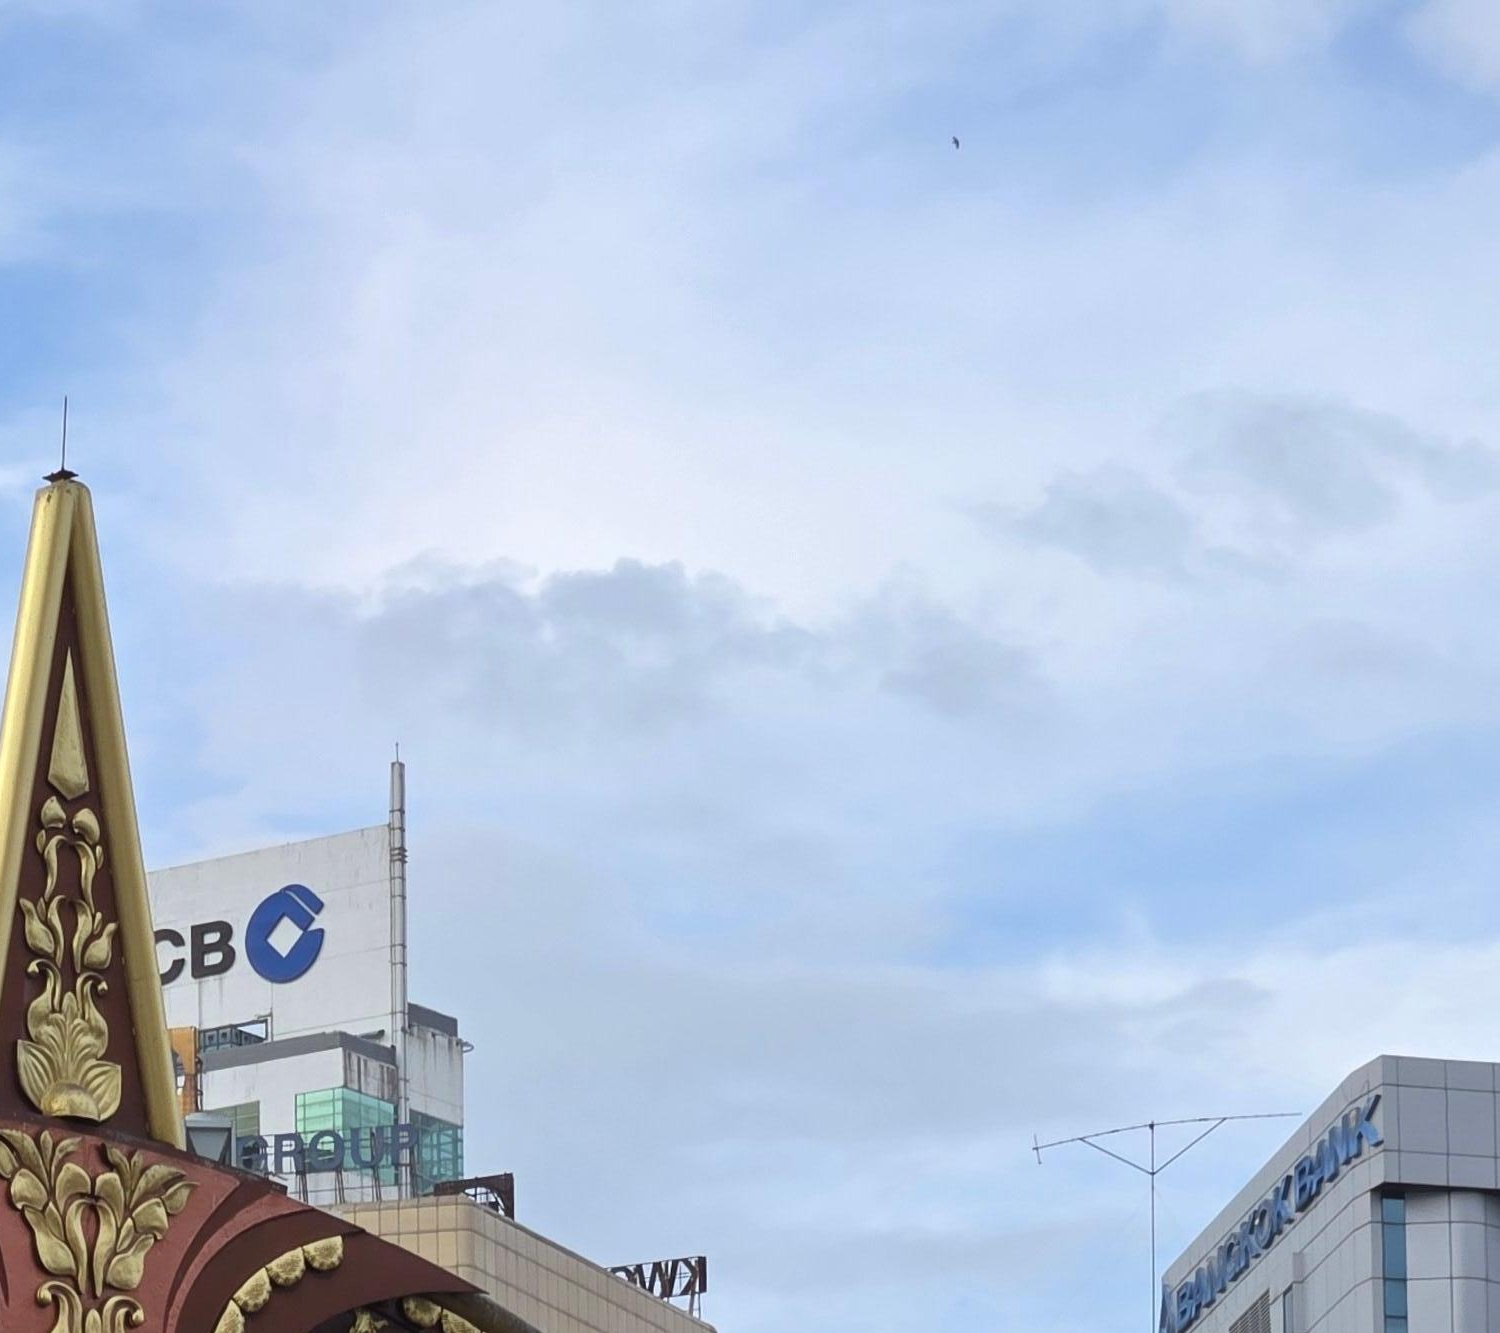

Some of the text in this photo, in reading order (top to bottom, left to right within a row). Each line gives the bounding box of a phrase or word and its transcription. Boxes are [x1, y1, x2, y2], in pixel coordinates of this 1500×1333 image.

[236, 1123, 419, 1174] GROUP
[1176, 1094, 1384, 1333] BANGKOK BANK
